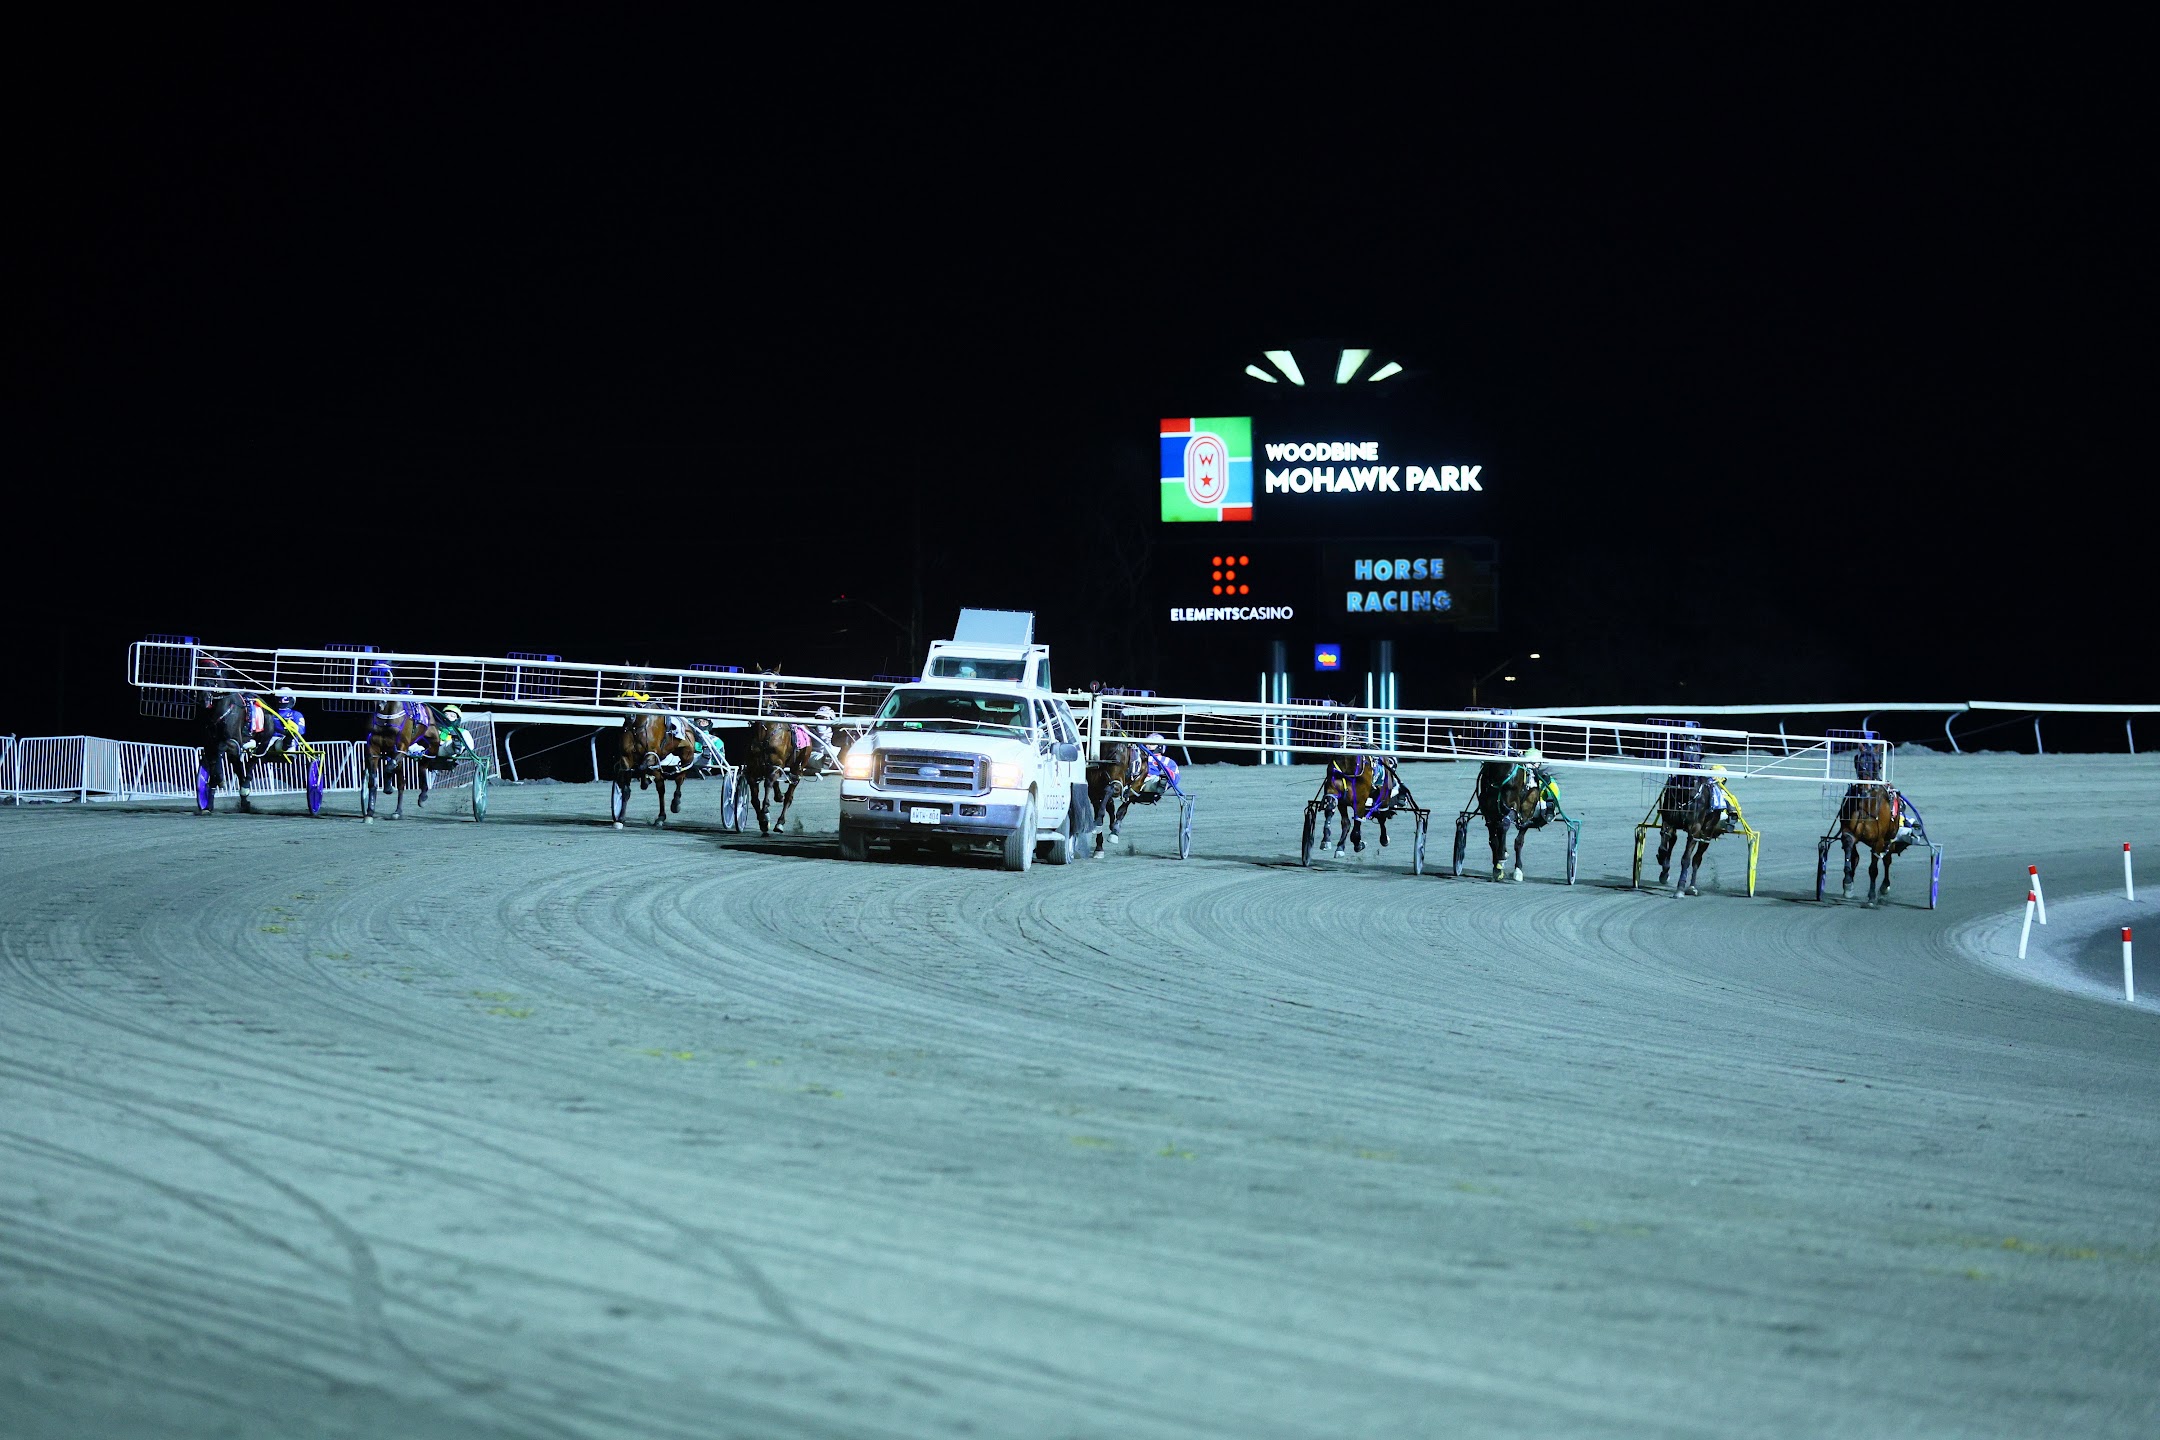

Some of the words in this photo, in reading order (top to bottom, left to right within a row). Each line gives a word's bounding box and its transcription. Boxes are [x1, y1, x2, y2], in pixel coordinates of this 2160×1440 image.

[1199, 453, 1214, 466] W
[1265, 442, 1379, 462] WOODBINE
[1265, 466, 1400, 493] MOHAWK
[1406, 465, 1483, 492] PARK
[1355, 558, 1444, 581] HORSE
[1346, 590, 1451, 612] RACING
